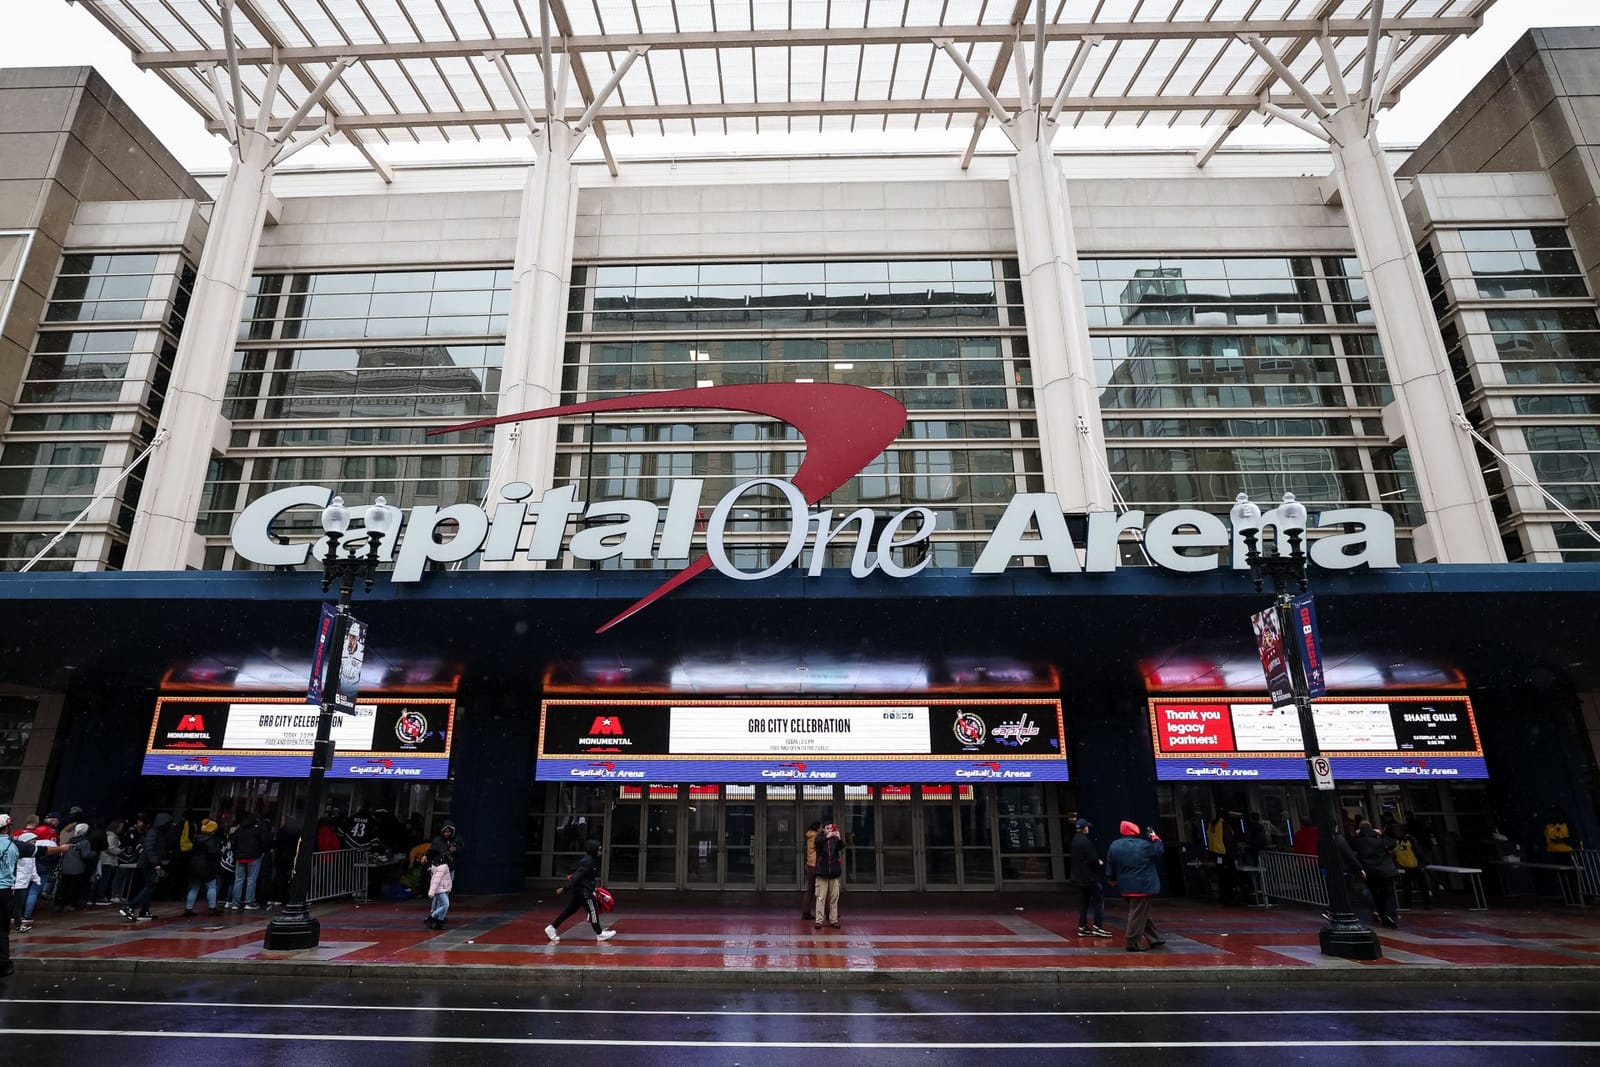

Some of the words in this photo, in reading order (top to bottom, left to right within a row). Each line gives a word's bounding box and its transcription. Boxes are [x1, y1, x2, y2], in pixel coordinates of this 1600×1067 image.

[259, 715, 274, 727] GR8
[274, 715, 292, 727] CITY
[294, 715, 343, 727] CELEBRON
[1165, 710, 1199, 720] Thank
[1200, 712, 1221, 722] you
[1403, 713, 1431, 722] SHANE
[1432, 713, 1458, 722] GILLIS
[748, 718, 766, 733] GR8
[768, 718, 788, 733] CITY
[790, 718, 851, 733] CELEBRATION
[1167, 722, 1204, 734] legacy
[1169, 734, 1218, 747] partners!
[210, 765, 237, 773] Arena
[1431, 767, 1458, 775] Arena
[351, 822, 366, 838] 43
